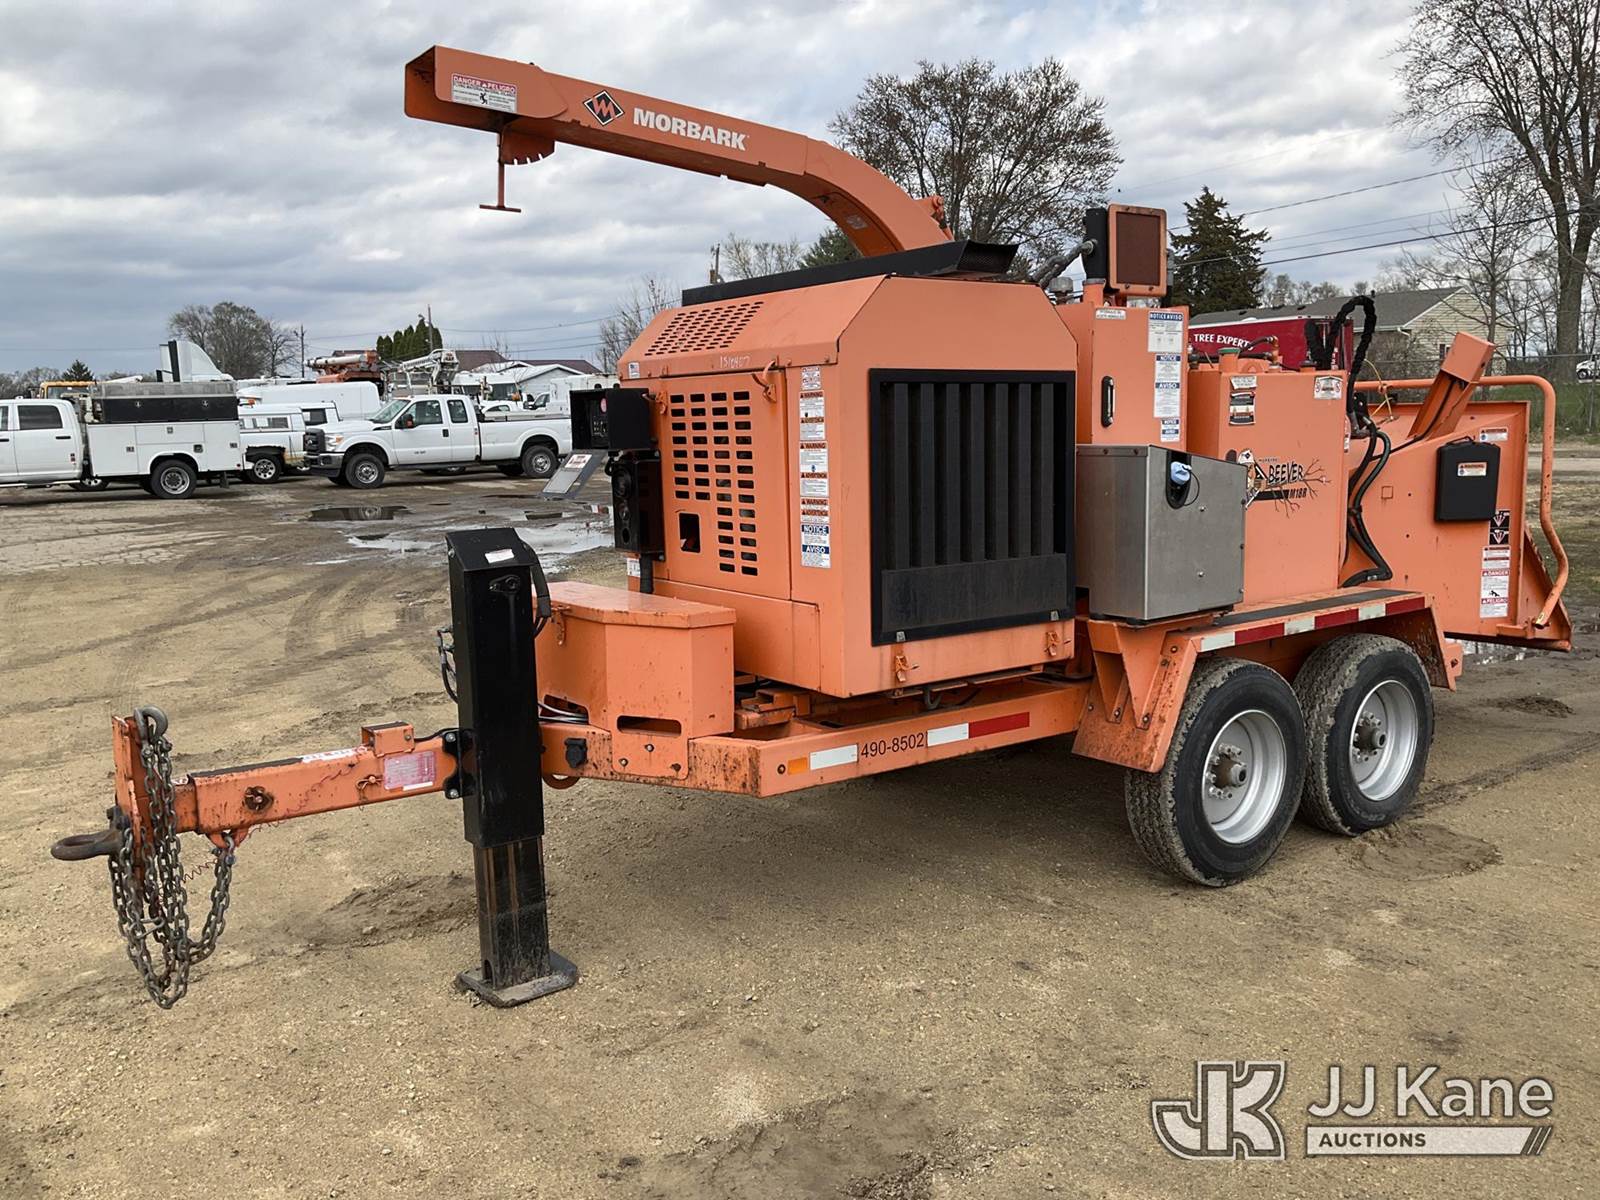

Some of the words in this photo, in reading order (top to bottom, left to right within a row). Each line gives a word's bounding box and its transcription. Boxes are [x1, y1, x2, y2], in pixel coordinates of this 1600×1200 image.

[453, 76, 481, 86] DANGER
[487, 82, 516, 93] PELIGRO
[633, 107, 747, 151] MORBARK
[1193, 333, 1216, 343] TREE
[1269, 461, 1304, 483] BEEVER
[803, 525, 828, 534] NOTICE
[805, 545, 826, 554] AVISO
[860, 732, 925, 758] 490-8502
